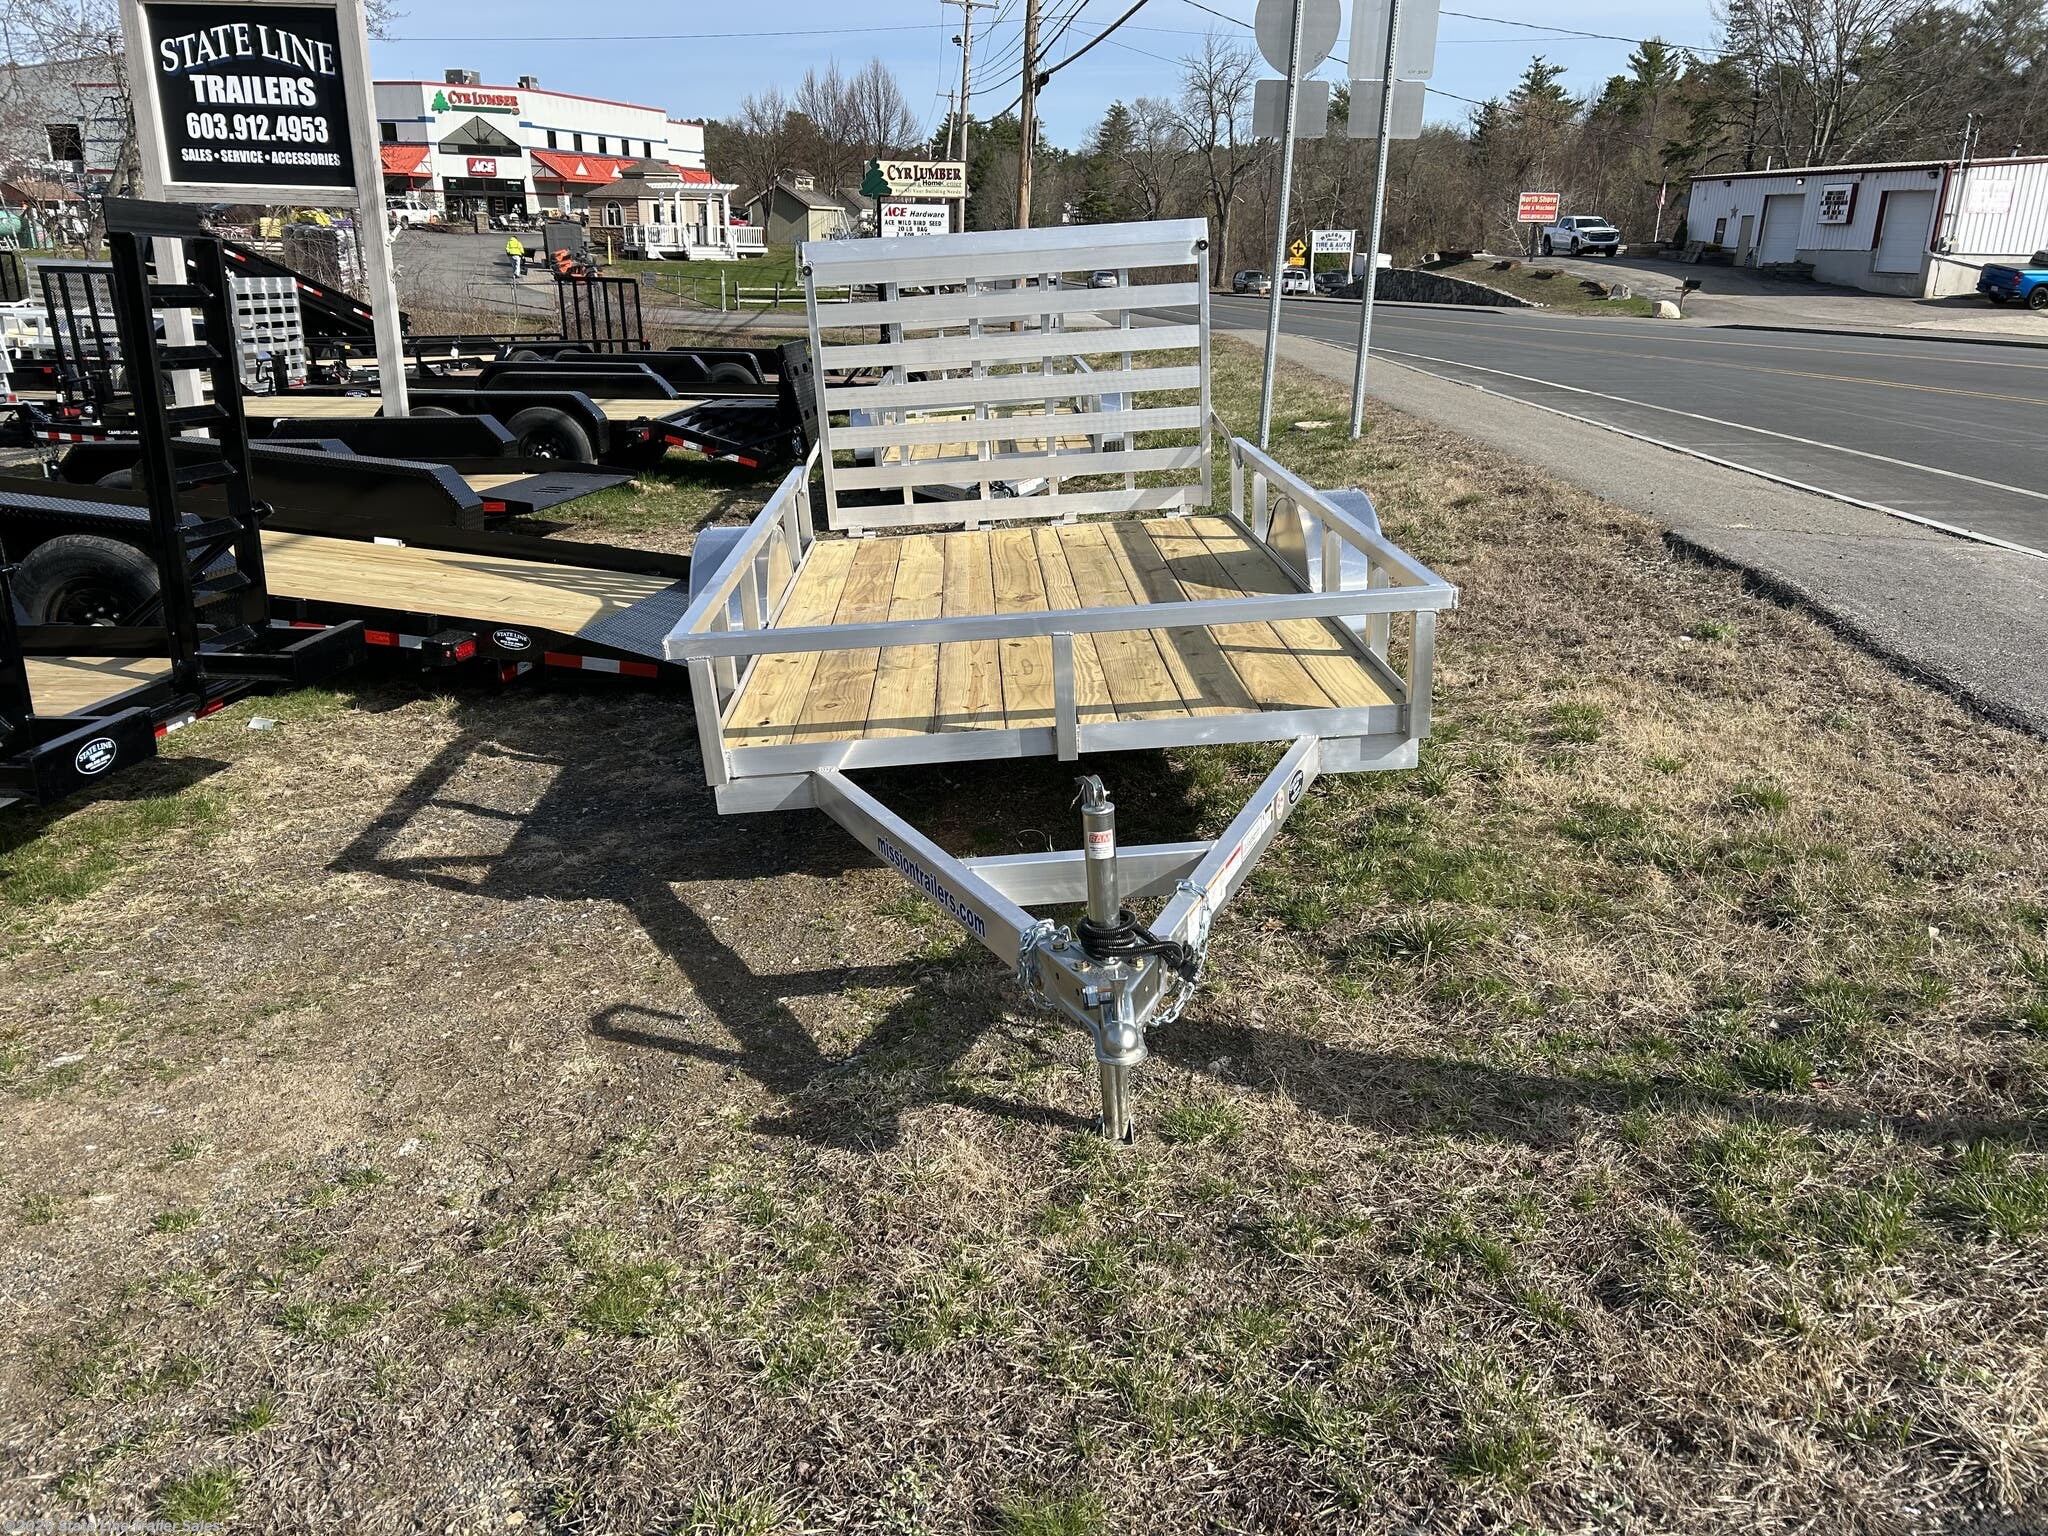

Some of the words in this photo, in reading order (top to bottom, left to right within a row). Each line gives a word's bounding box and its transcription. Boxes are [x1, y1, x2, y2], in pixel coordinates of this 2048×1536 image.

[160, 23, 252, 72] STATE
[255, 24, 336, 75] LINE
[189, 74, 317, 107] TRAILERS
[447, 90, 472, 104] CYR
[472, 92, 519, 106] LUMBER
[186, 112, 329, 143] 603.912.4953
[181, 148, 213, 162] SALES
[220, 150, 264, 164] SERVICE
[271, 151, 341, 167] ACCESSORIES
[471, 160, 495, 173] ACE
[887, 164, 913, 181] CYR
[913, 165, 962, 181] LUMBER
[884, 207, 907, 217] ACE
[910, 210, 945, 218] Hardware
[79, 744, 97, 762] STATE
[97, 741, 113, 750] LINE
[877, 836, 986, 938] missiontrailers.com
